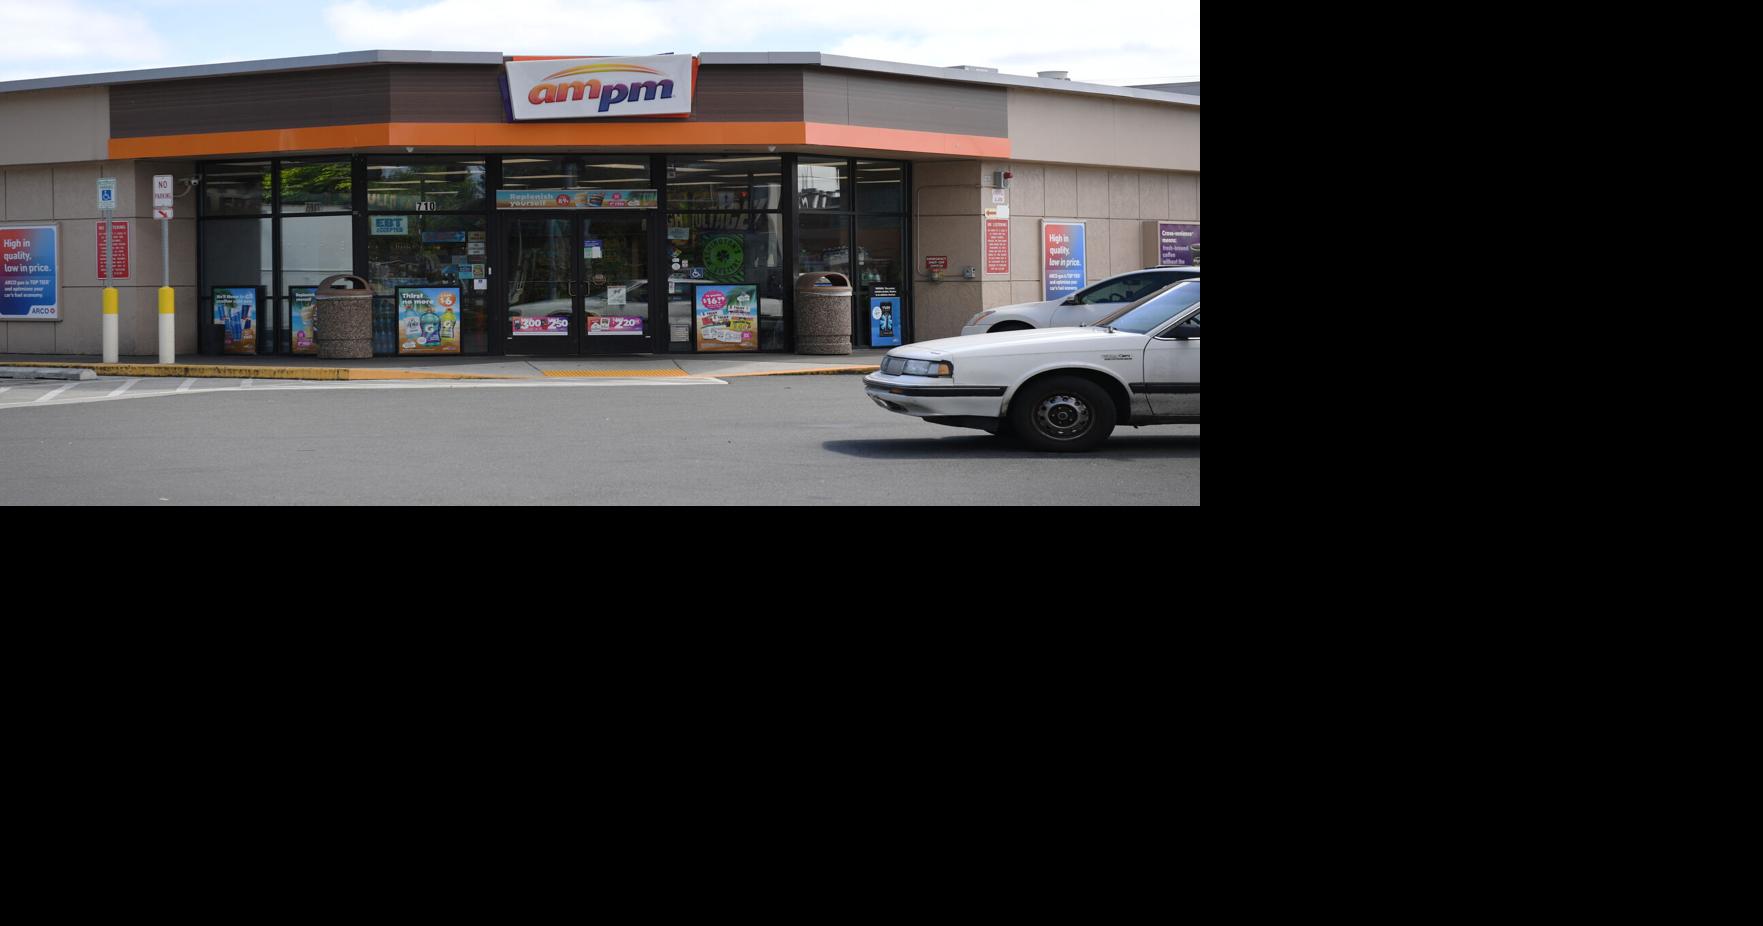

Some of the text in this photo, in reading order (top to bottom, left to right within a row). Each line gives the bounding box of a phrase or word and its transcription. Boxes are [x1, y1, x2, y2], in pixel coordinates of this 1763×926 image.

[528, 79, 674, 112] ampm
[158, 180, 168, 189] NO
[510, 192, 553, 200] Replenish
[415, 202, 436, 211] 710
[375, 219, 403, 227] EBT
[1049, 233, 1069, 244] High in
[3, 239, 31, 249] High in
[3, 251, 32, 261] quality,
[1049, 246, 1070, 256] quality,
[1049, 258, 1082, 268] low in price.
[4, 264, 52, 274] low in price.
